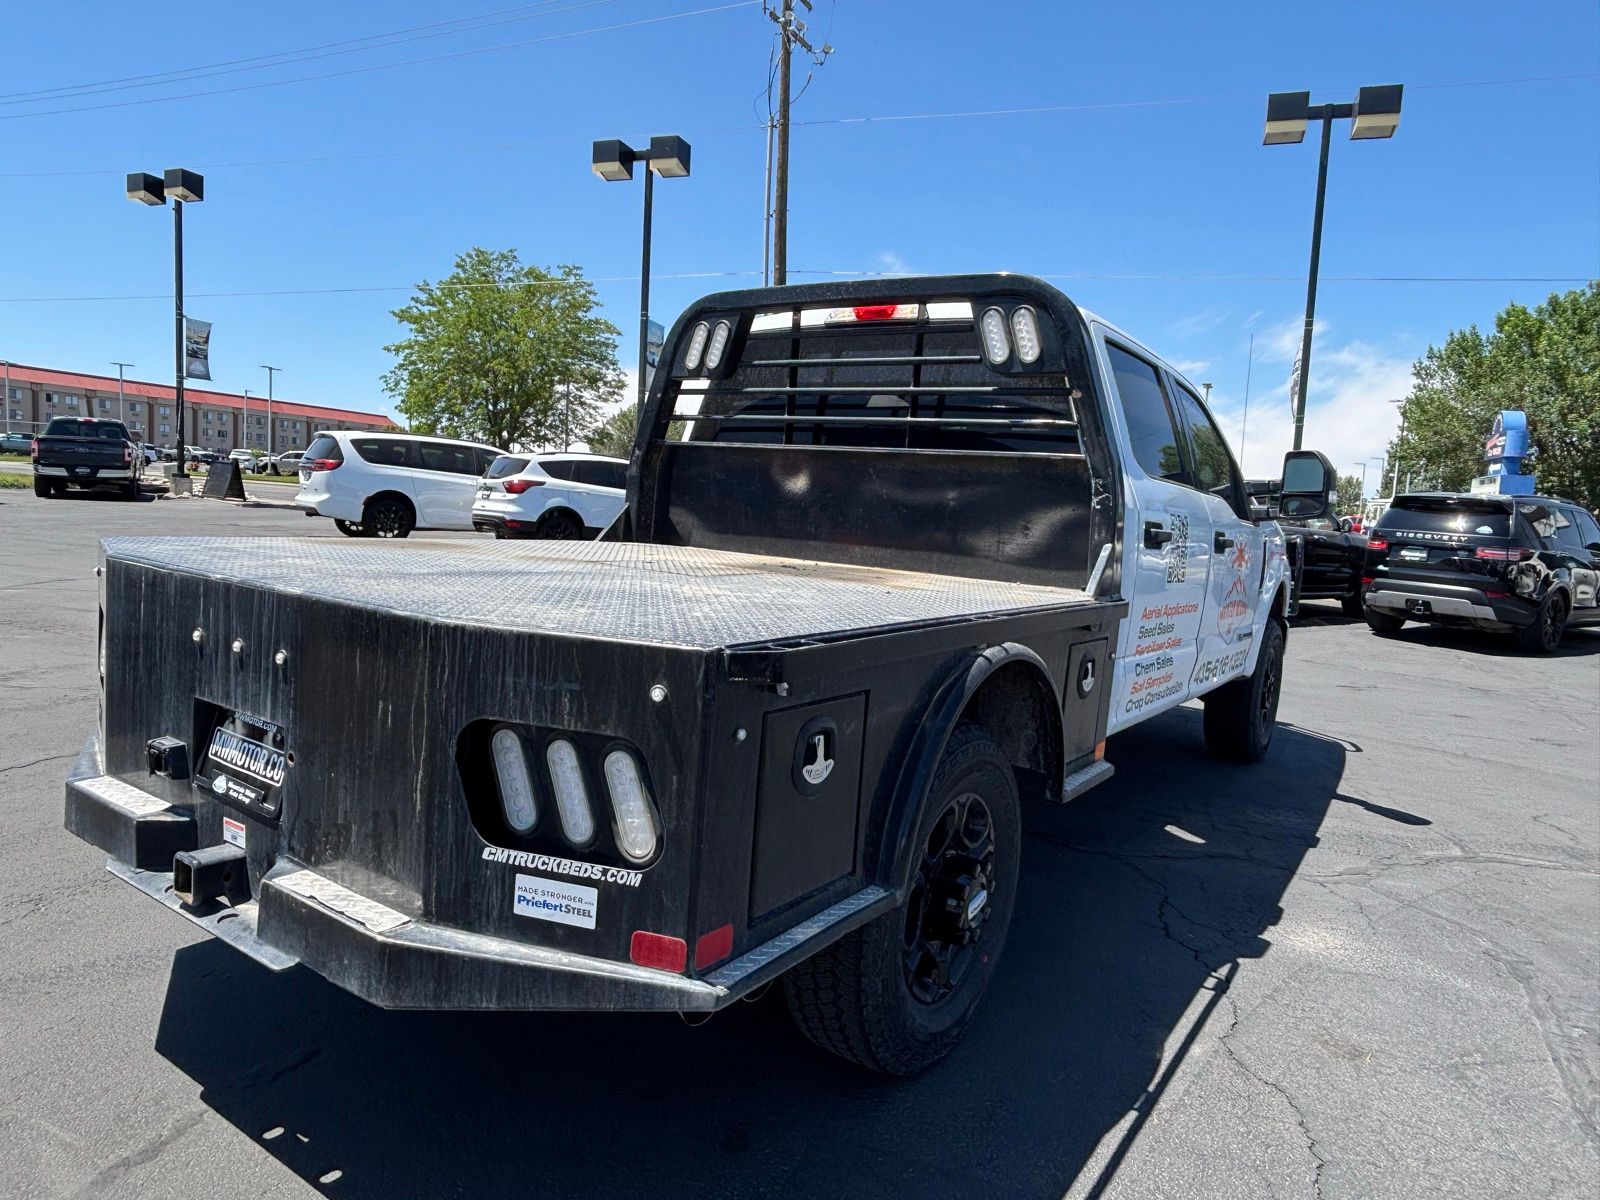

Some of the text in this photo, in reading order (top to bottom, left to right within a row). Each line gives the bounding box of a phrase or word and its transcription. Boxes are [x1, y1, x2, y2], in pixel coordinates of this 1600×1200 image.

[1396, 532, 1468, 542] DISCOVERY
[1141, 605, 1163, 621] Aerial
[1163, 601, 1199, 620] Applications
[1138, 621, 1175, 639] Seed Sales
[1134, 636, 1182, 657] Fertilizer Sales
[1135, 656, 1174, 677] Chem Sales
[1125, 681, 1183, 713] Crop Consultation
[481, 846, 643, 887] CMTRUCKBEDS.COM
[518, 886, 539, 896] MADE
[541, 890, 584, 904] STRONGER
